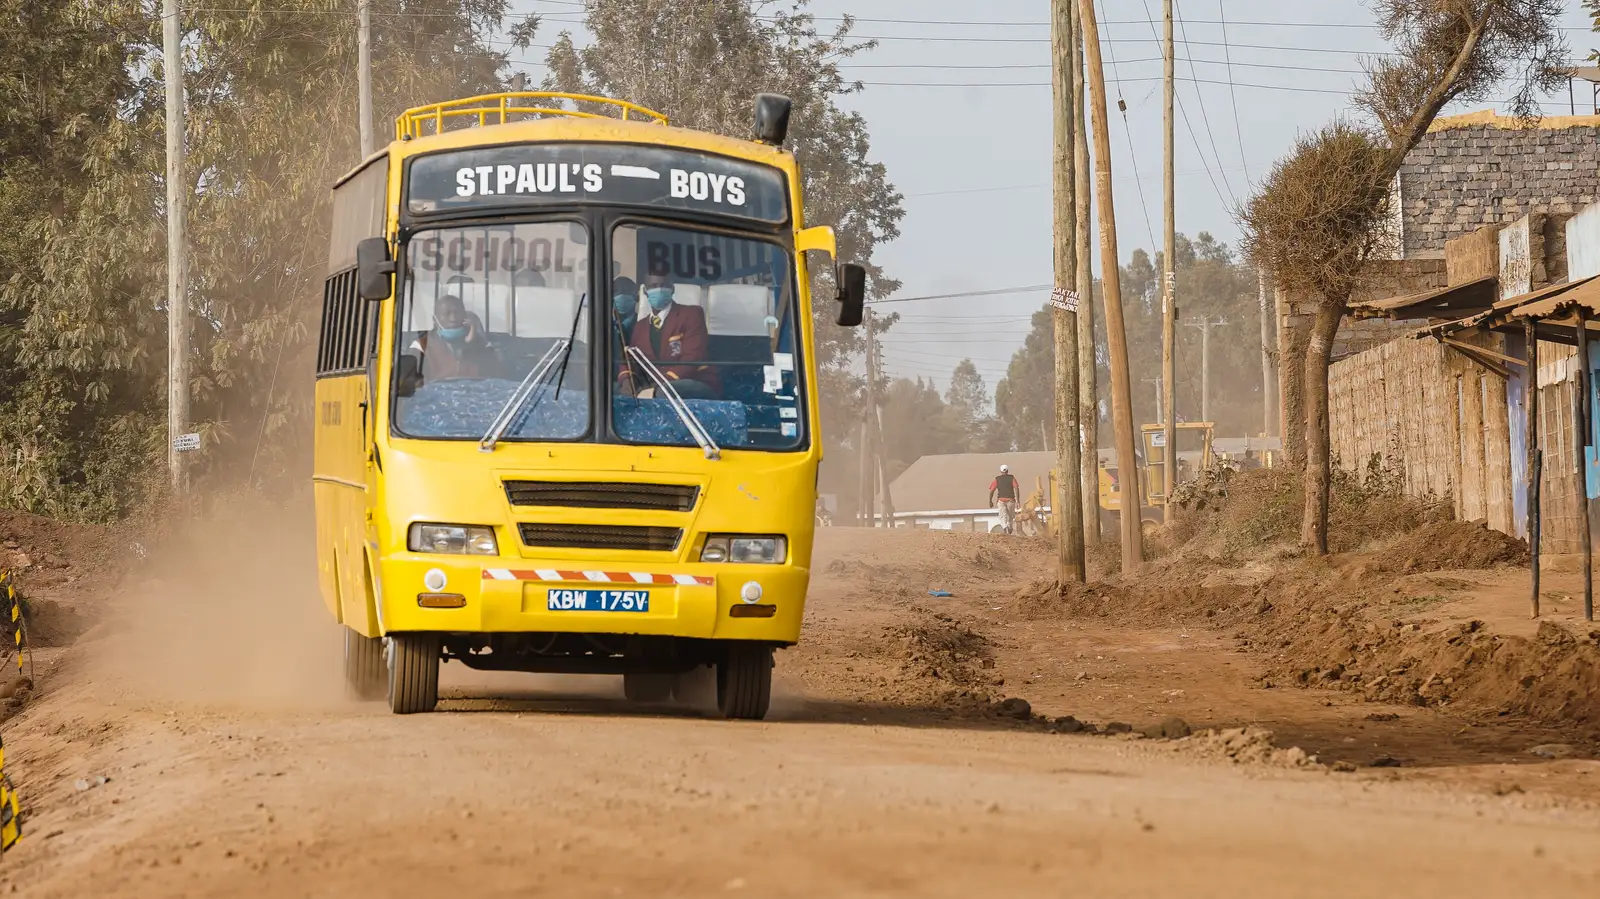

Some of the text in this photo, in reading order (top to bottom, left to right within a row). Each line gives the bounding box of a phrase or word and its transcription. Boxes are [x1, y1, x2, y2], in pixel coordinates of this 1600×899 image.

[670, 168, 746, 206] BOYS
[422, 236, 721, 281] SCHOOL BUS
[549, 590, 647, 611] KBW 175V
